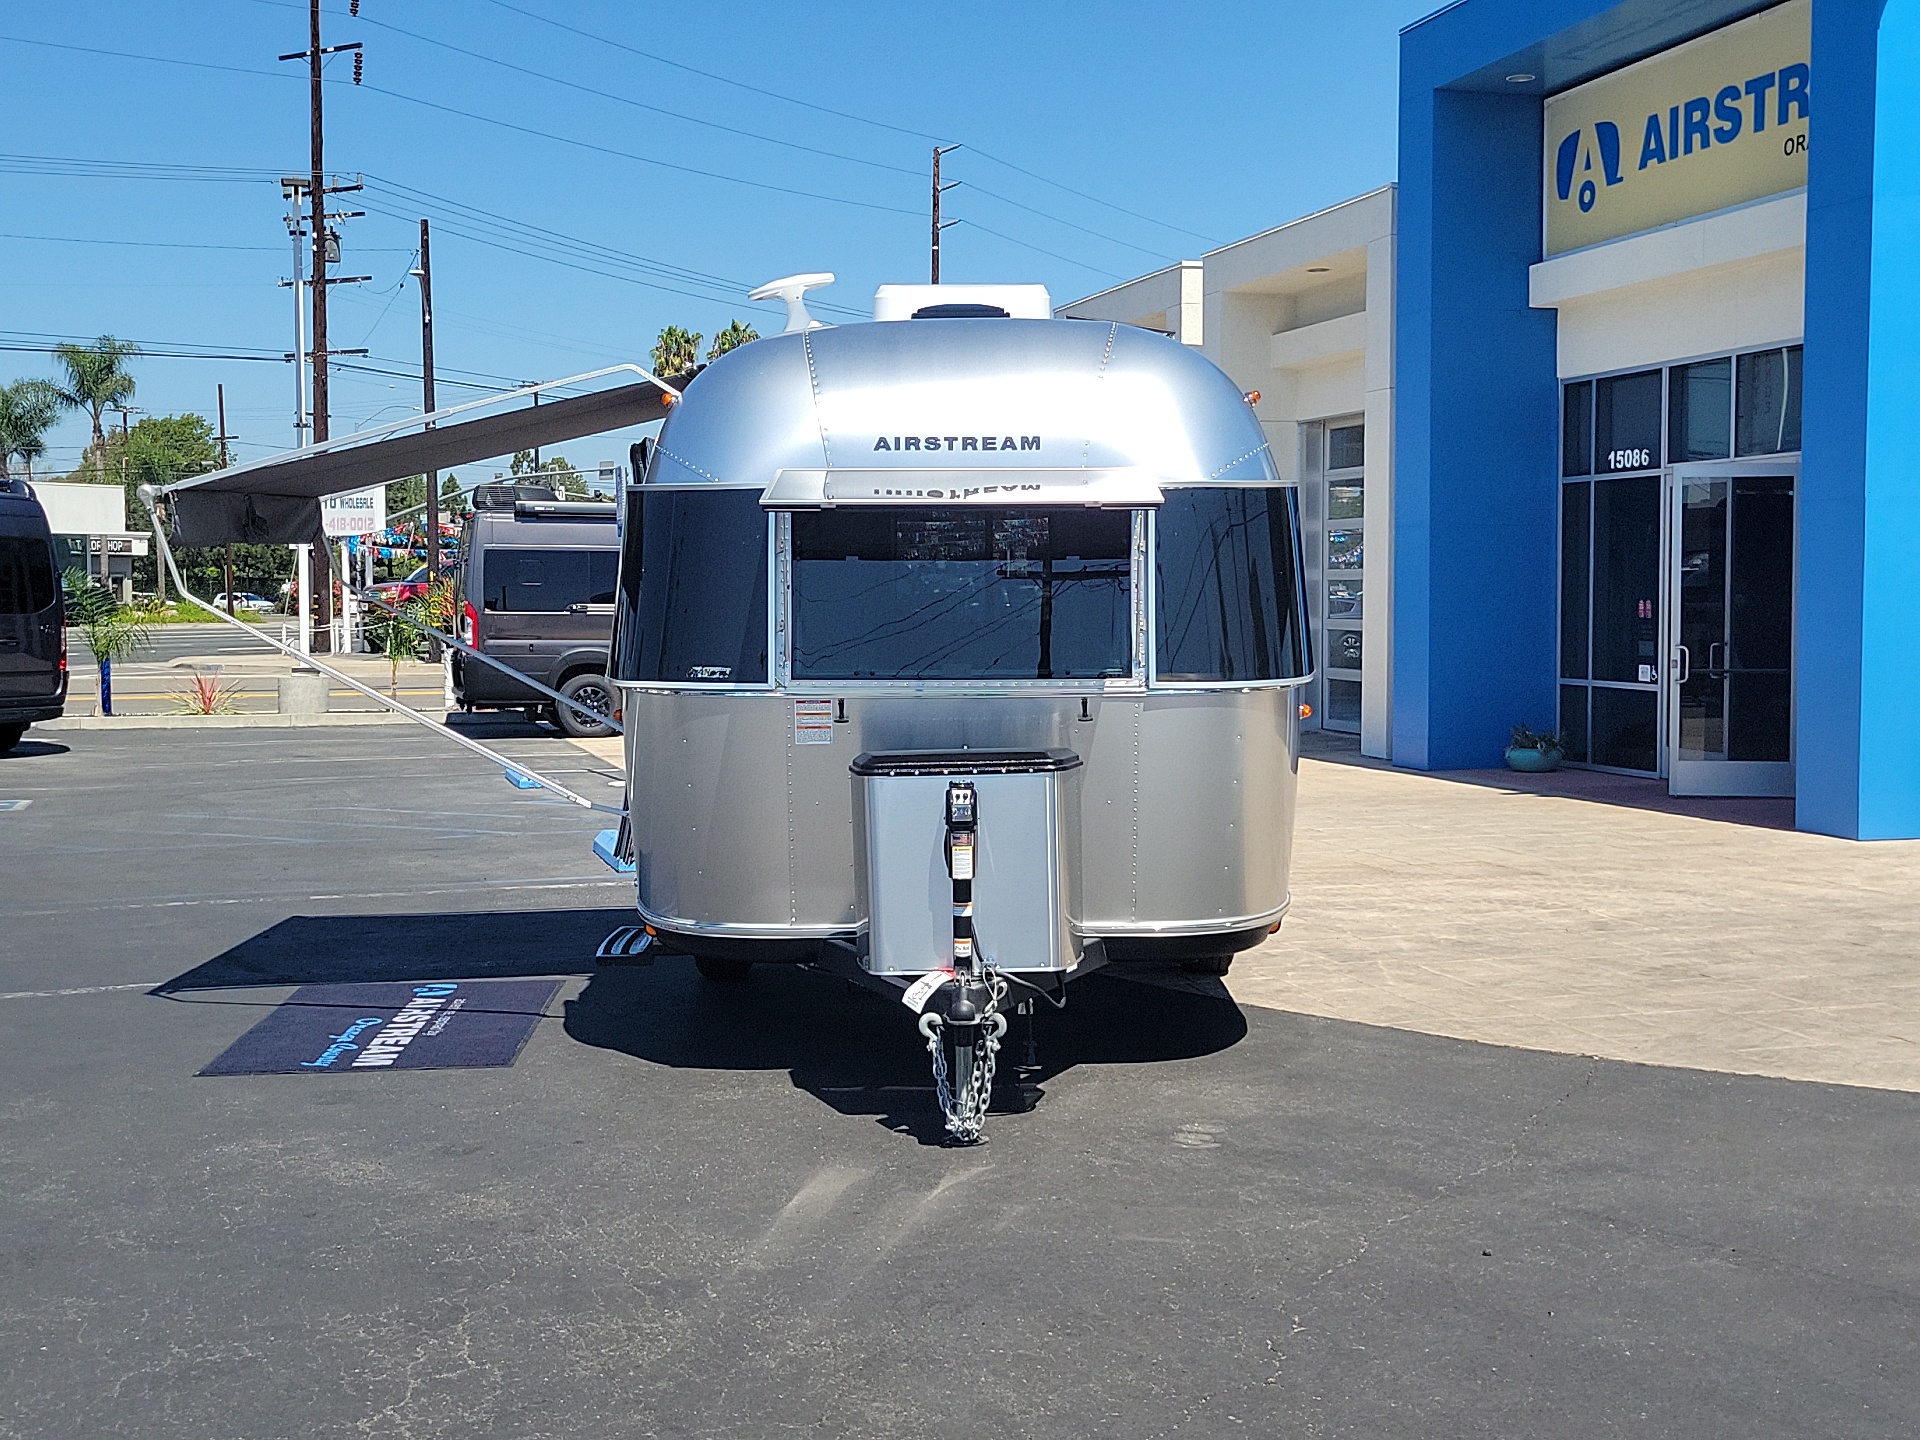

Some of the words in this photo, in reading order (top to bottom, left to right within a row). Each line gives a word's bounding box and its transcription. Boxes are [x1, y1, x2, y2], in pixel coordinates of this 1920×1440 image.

[1638, 62, 1809, 171] AIRSTR
[1784, 133, 1808, 157] OR
[874, 436, 1041, 451] AIRSTREAM
[1608, 448, 1650, 469] 15086
[340, 497, 374, 509] WHOLESALE
[328, 1017, 383, 1042] Orange
[351, 997, 448, 1067] AIRSTREAM
[300, 1043, 359, 1067] County
